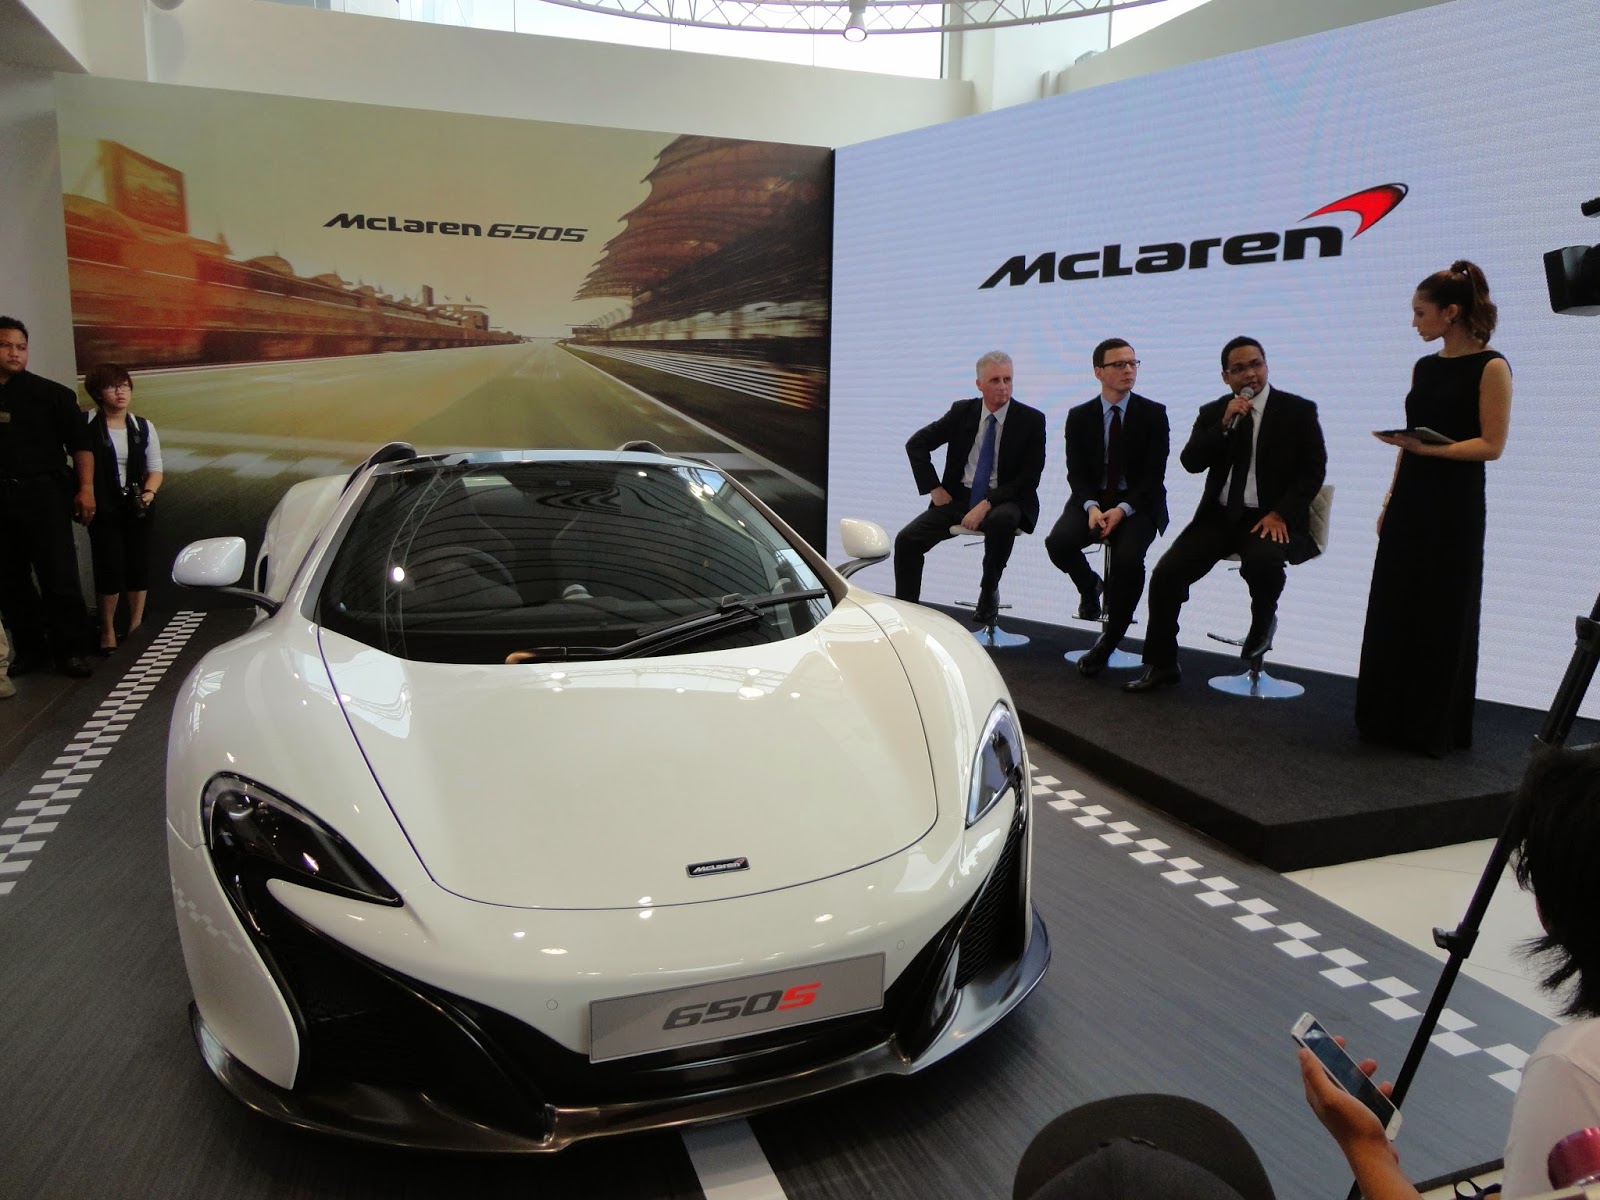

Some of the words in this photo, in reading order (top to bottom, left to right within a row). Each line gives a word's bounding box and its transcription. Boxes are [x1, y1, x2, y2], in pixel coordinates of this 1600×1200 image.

[323, 213, 482, 237] McLaren
[487, 223, 589, 243] 650S
[977, 225, 1344, 290] McLaren
[692, 862, 741, 873] McLaren
[662, 982, 823, 1031] 650S
